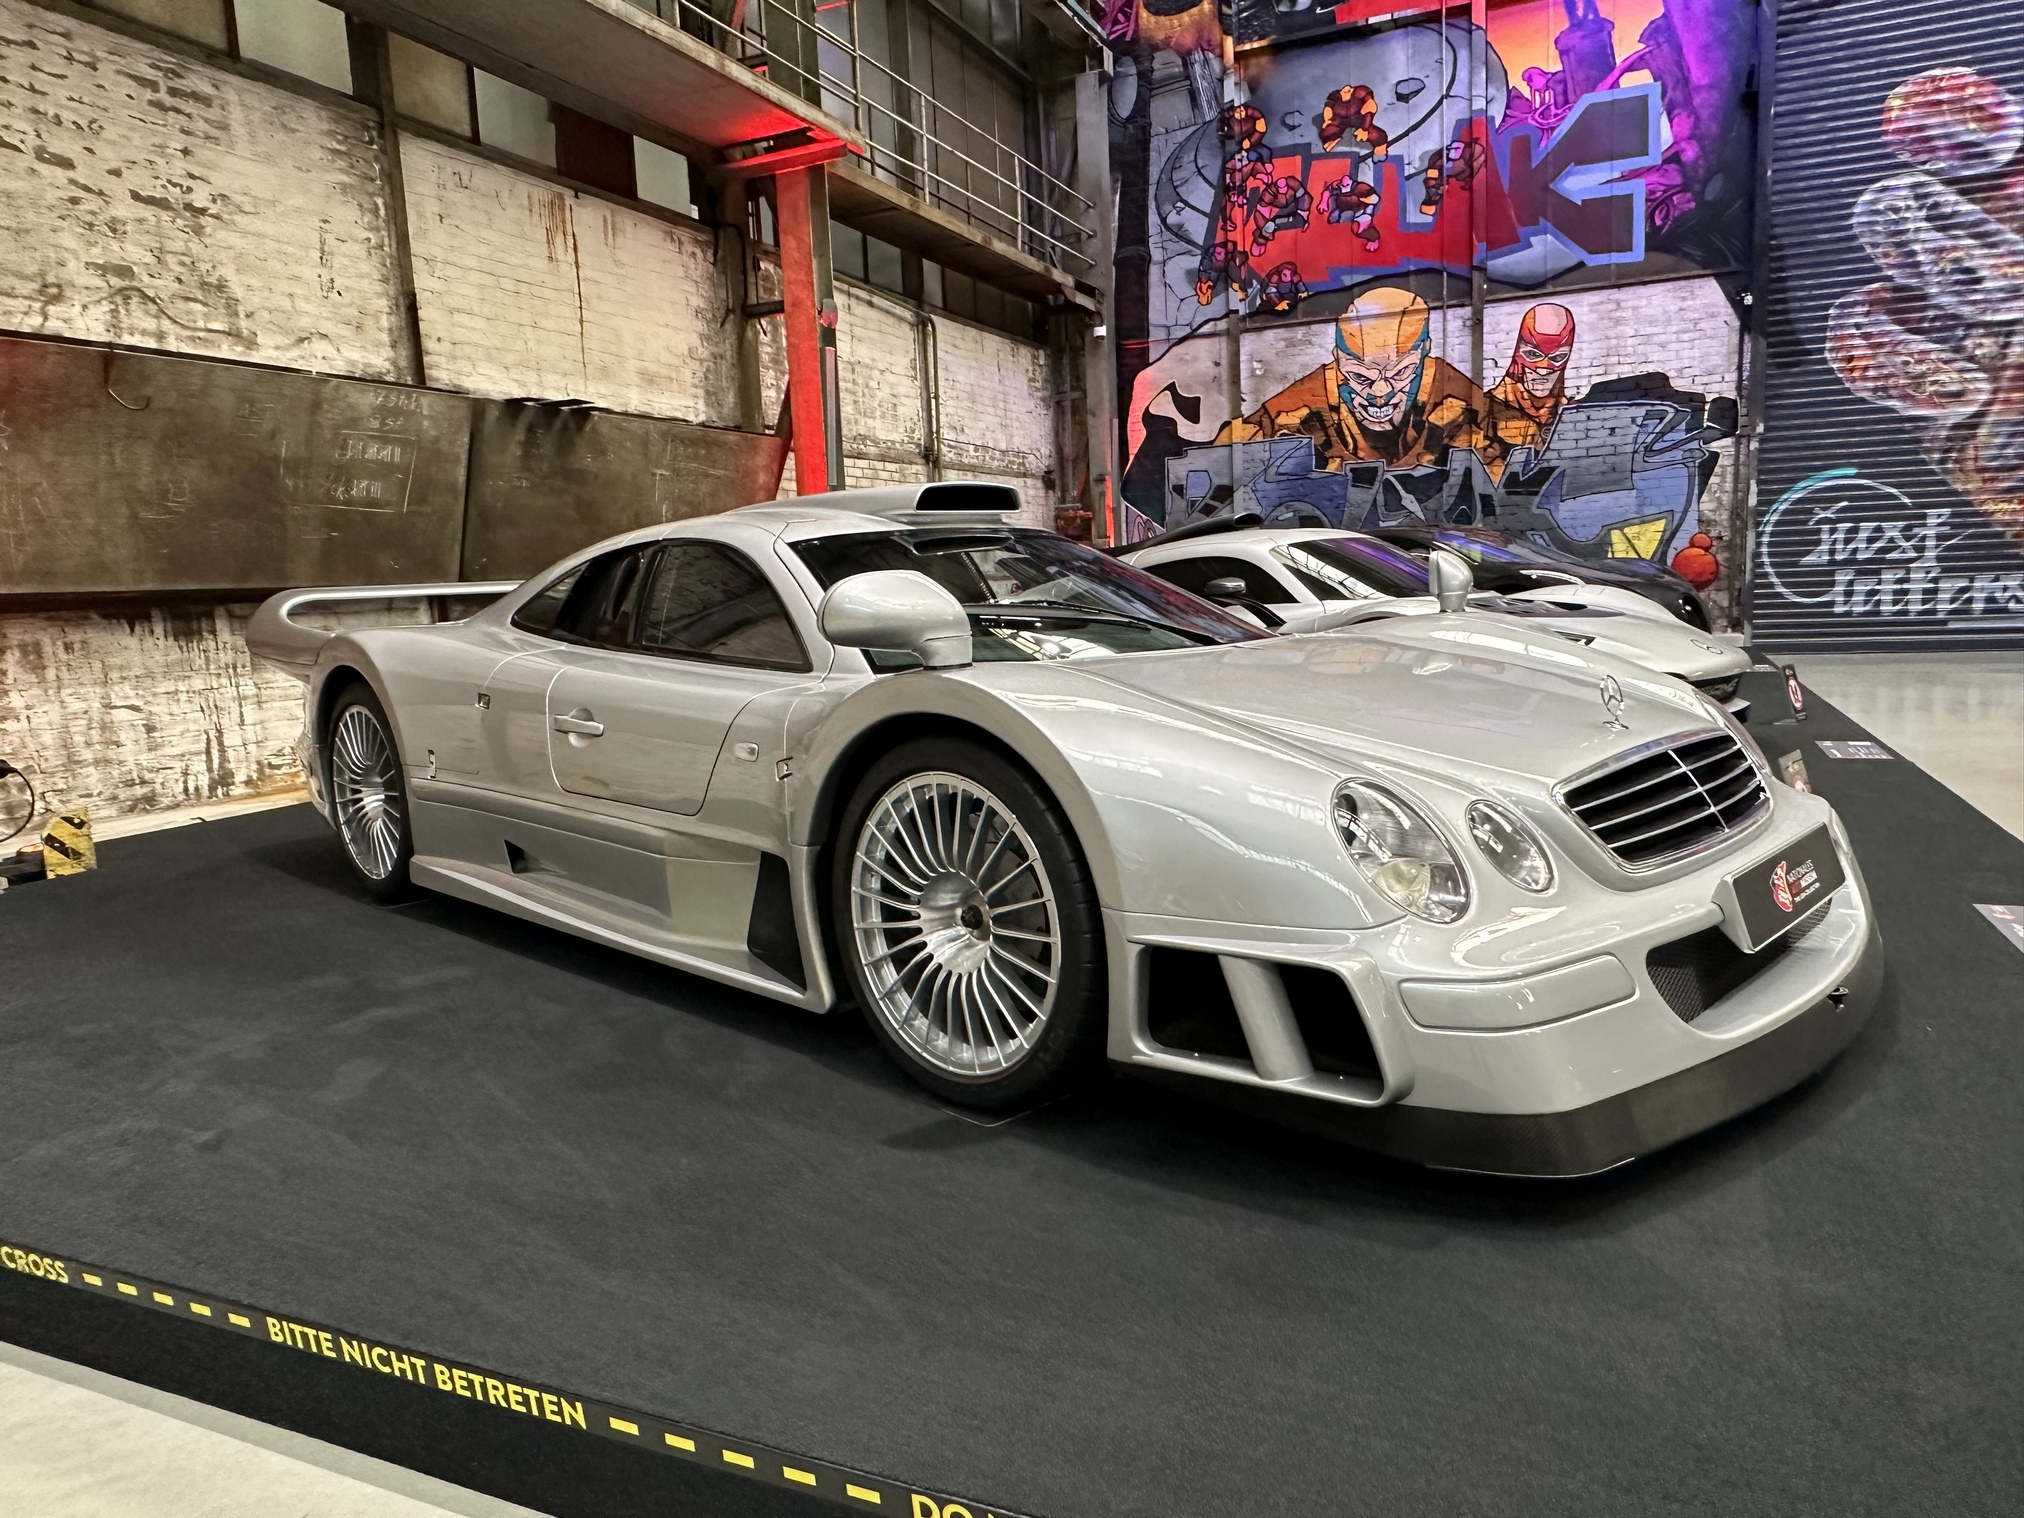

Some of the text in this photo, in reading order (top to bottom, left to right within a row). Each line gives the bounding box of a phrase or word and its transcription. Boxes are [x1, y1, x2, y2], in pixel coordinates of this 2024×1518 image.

[0, 1246, 69, 1283] CROSS
[266, 1316, 587, 1430] BITTE NICHT BETRETEN
